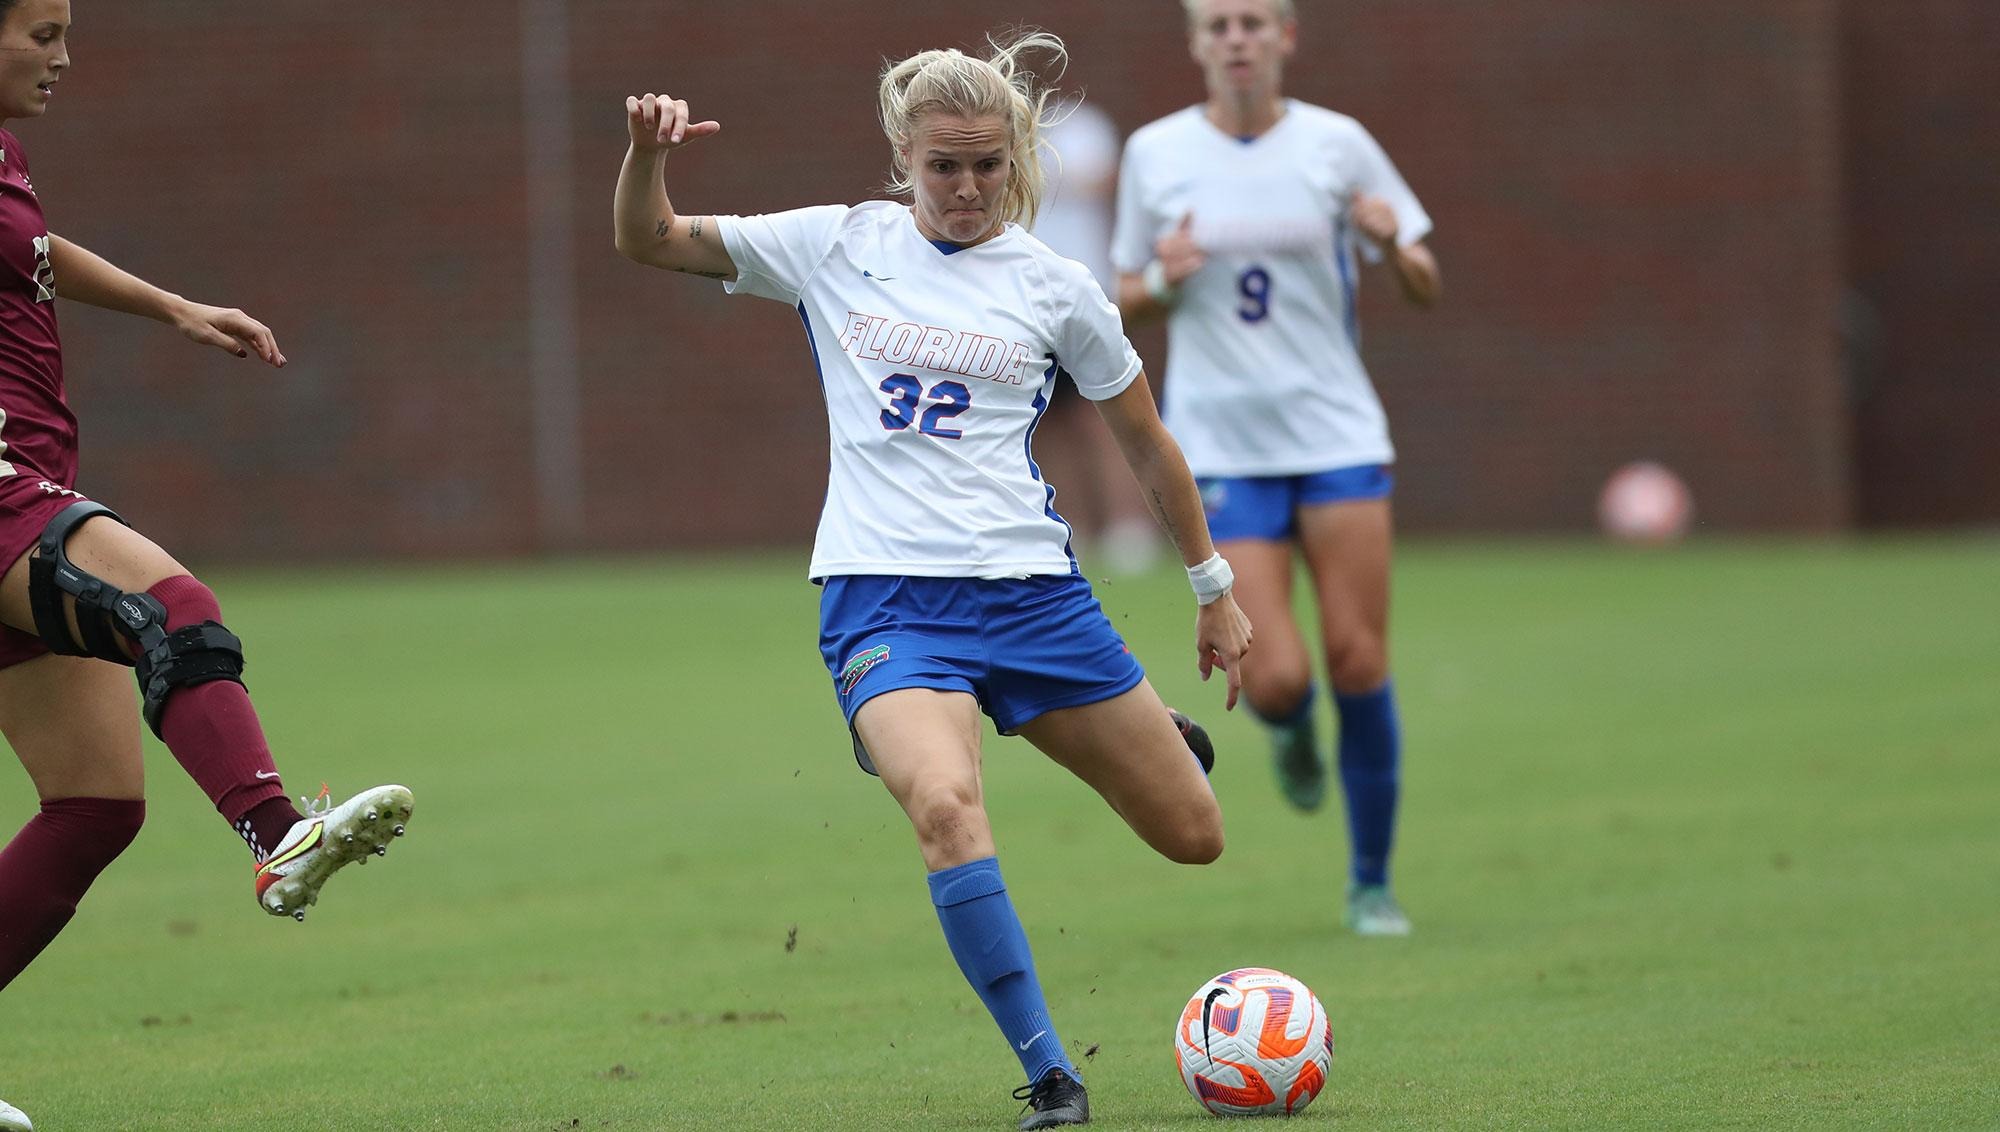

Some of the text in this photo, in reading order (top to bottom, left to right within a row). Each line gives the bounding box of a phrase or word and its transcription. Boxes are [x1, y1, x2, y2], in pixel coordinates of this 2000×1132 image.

[1236, 264, 1271, 324] 9
[838, 311, 1031, 386] FLORIDA
[878, 372, 972, 441] 32
